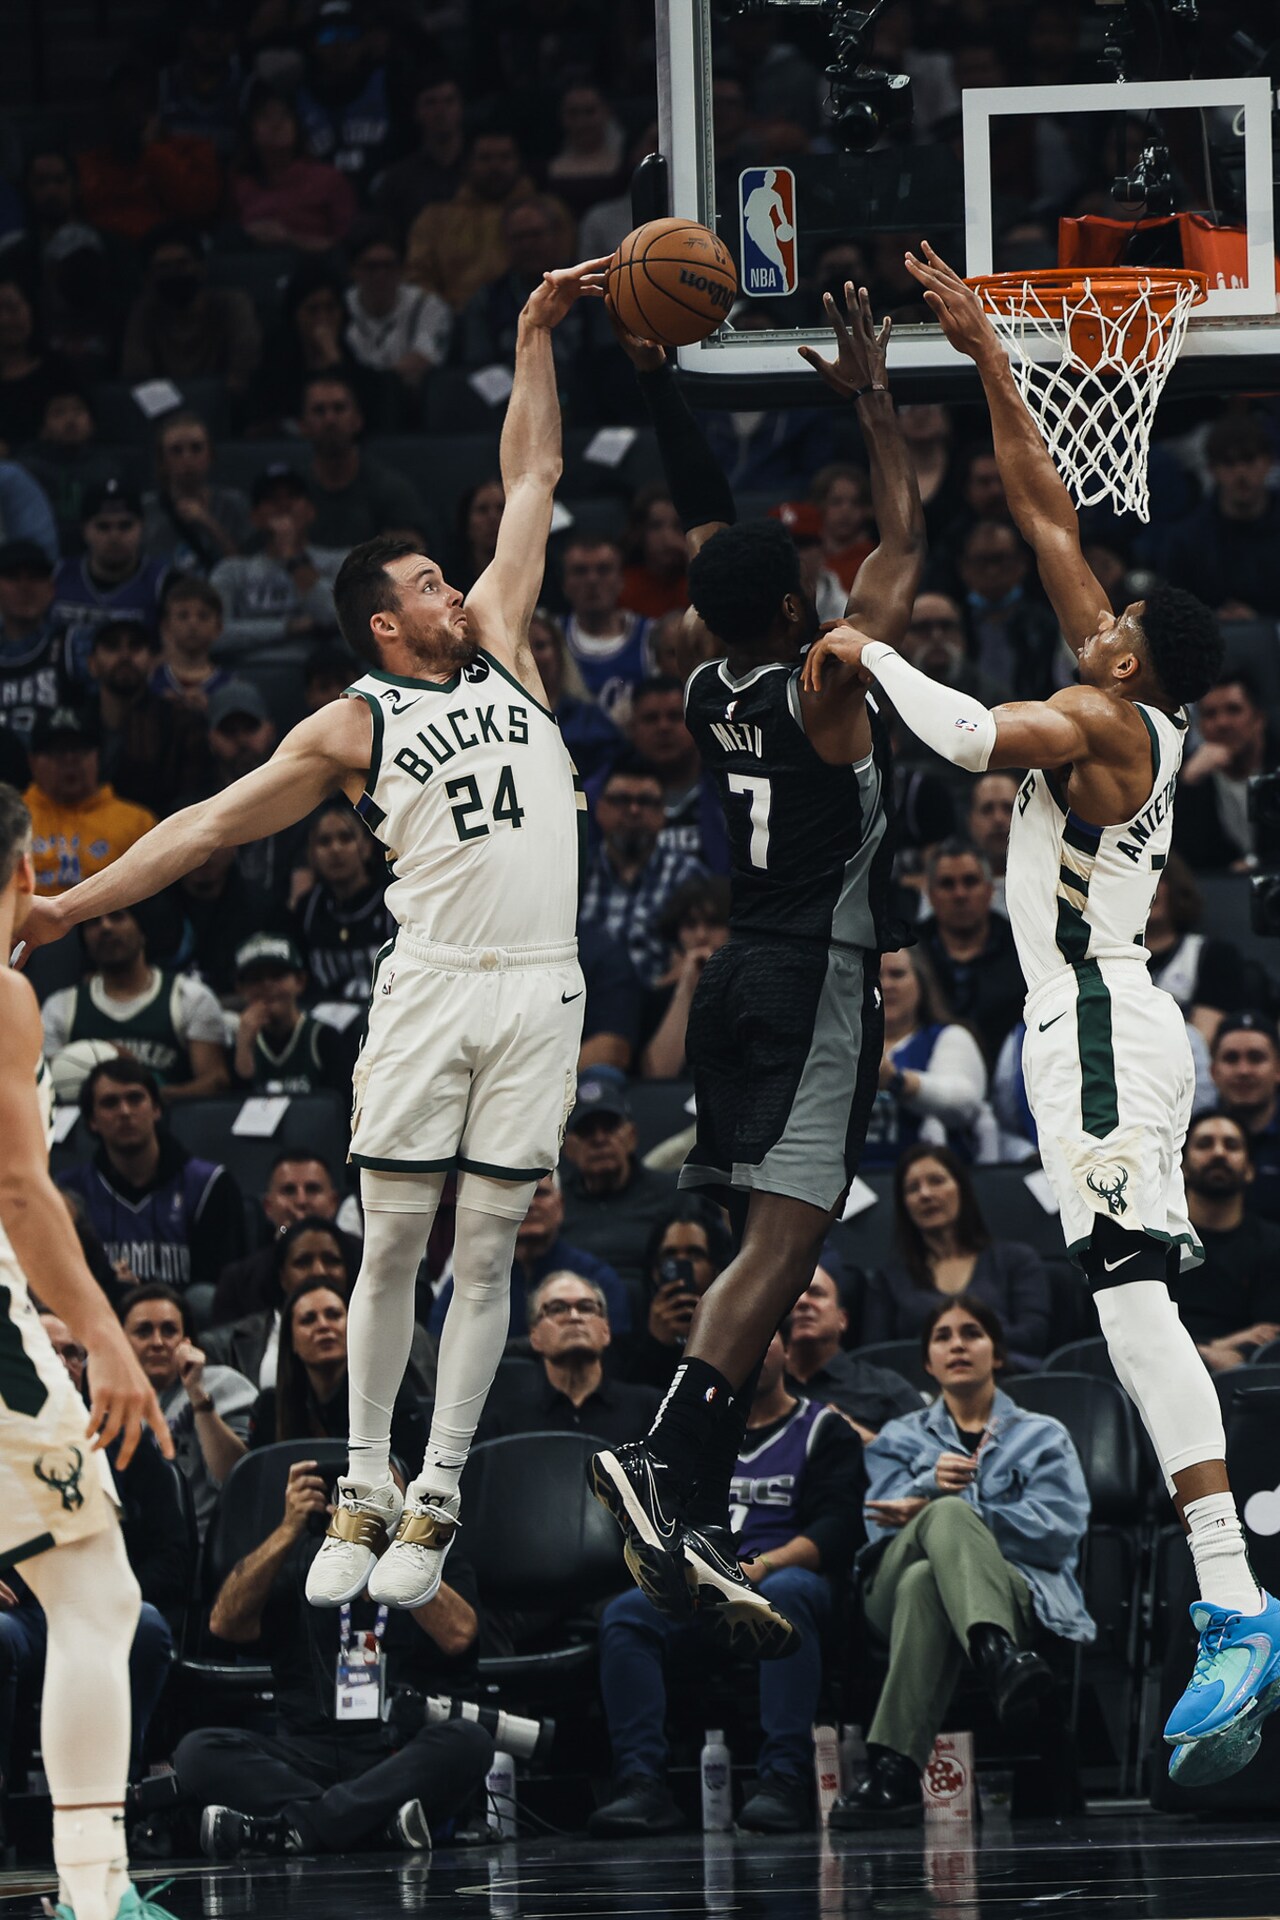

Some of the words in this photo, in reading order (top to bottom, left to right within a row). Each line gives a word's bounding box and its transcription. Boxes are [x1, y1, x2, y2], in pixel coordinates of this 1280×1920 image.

[750, 268, 777, 288] NBA
[393, 704, 528, 785] BUCKS
[709, 722, 763, 759] METU
[444, 765, 526, 842] 24
[727, 773, 771, 869] 7
